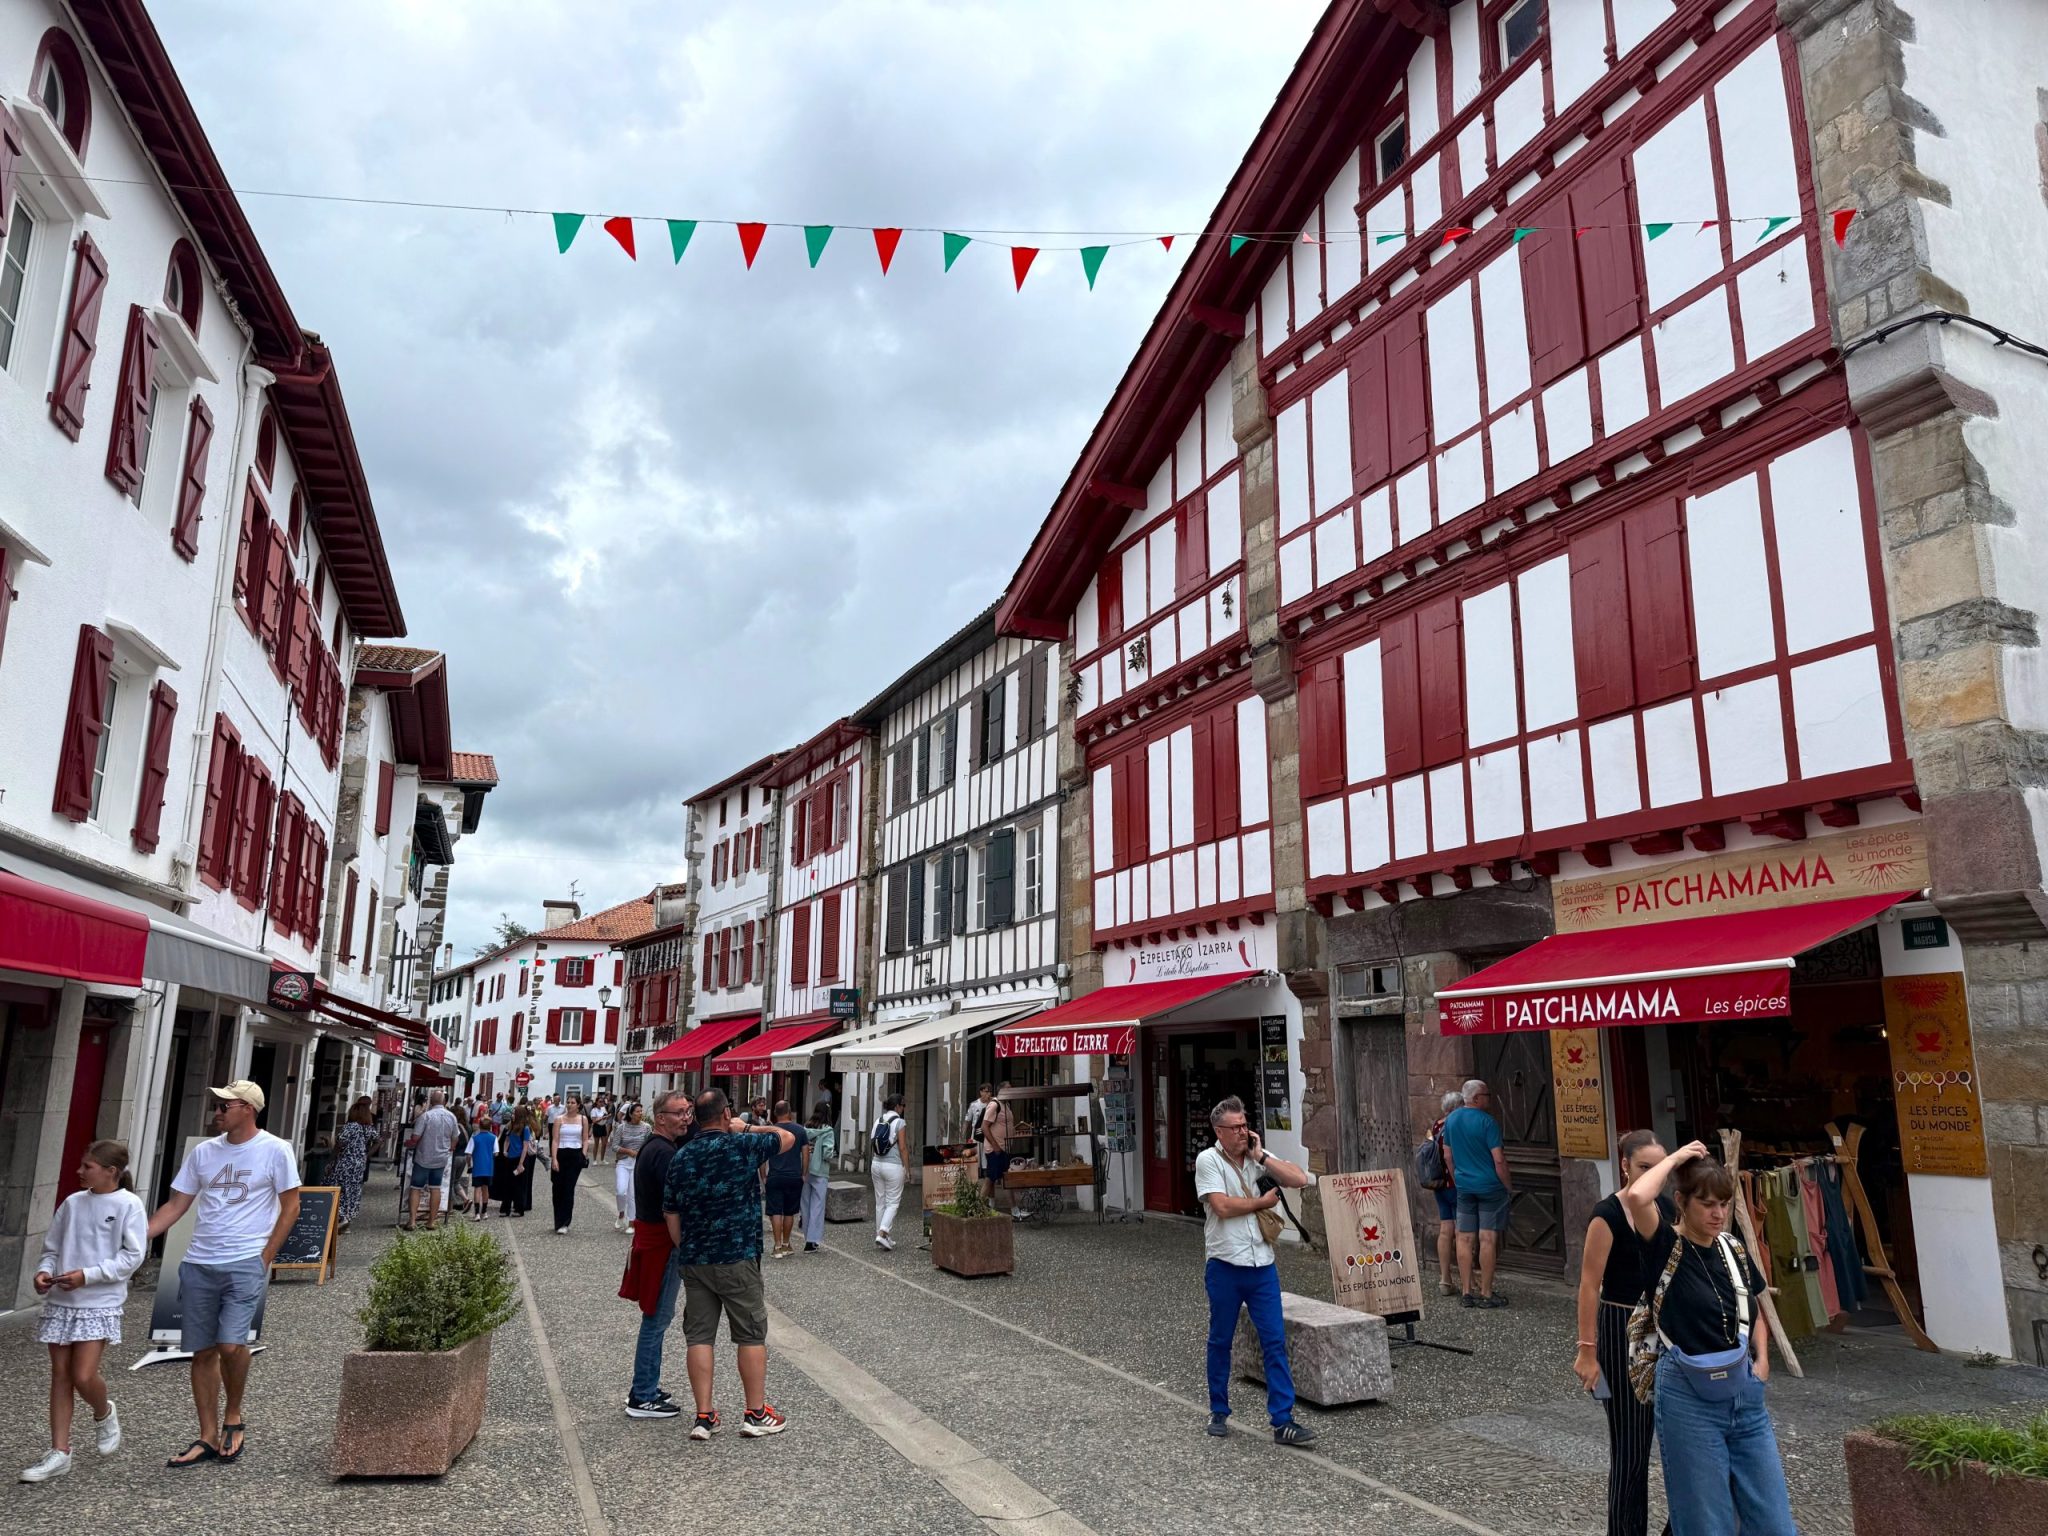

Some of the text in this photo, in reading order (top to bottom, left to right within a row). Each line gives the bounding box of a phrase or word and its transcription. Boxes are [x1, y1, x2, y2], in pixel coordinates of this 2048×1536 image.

[1847, 830, 1910, 850] Les épices
[1847, 843, 1913, 863] du monde
[1560, 881, 1602, 895] Les épices
[1615, 853, 1835, 914] PATCHAMAMA
[1562, 893, 1603, 905] du monde
[1140, 941, 1233, 965] EZPELETAKO IZARRA
[1450, 1000, 1484, 1009] PATCHAMAMA
[1505, 986, 1681, 1028] PATCHAMAMA
[1705, 994, 1787, 1016] Les épices
[1014, 1032, 1109, 1054] EZPELETAKO IZARRA
[551, 1061, 585, 1069] CAISSE
[1563, 1104, 1574, 1113] LES
[1910, 1103, 1969, 1117] LES ÉPICES
[1562, 1115, 1599, 1125] DU MONDE
[1910, 1120, 1971, 1132] DU MONDE
[208, 1163, 252, 1205] 45
[1332, 1174, 1393, 1188] PATCHAMAMA
[1339, 1284, 1352, 1294] LES
[1378, 1279, 1388, 1288] DU
[1389, 1275, 1416, 1286] MONDE
